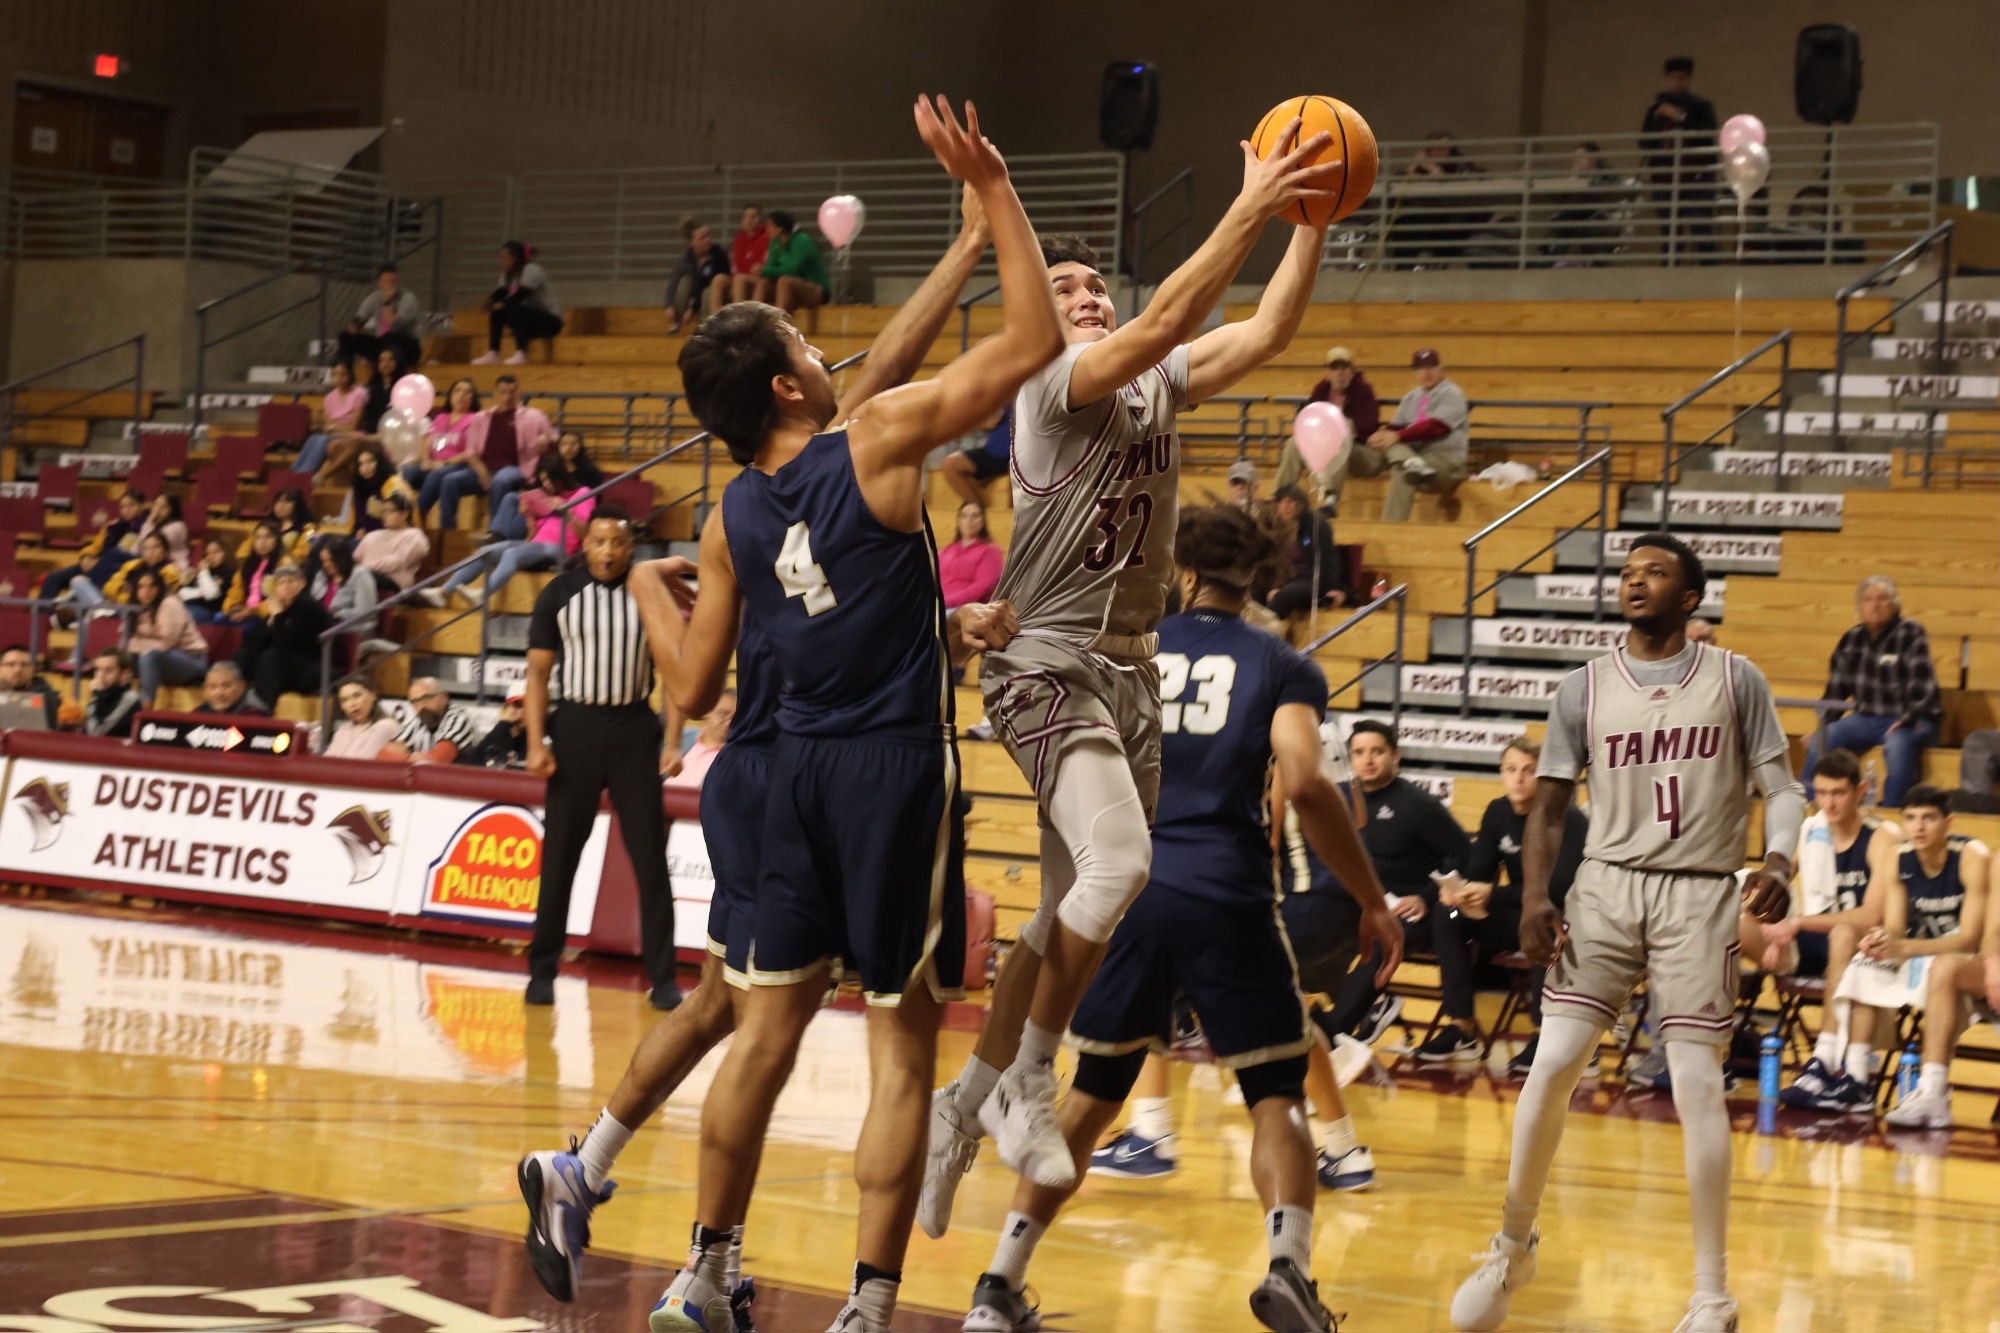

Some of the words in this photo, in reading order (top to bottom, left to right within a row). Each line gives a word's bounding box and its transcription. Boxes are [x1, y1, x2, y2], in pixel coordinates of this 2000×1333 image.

[1954, 304, 1987, 321] GO
[1886, 377, 1960, 399] TAMIU
[1725, 456, 1779, 475] FIGHT
[1760, 501, 1785, 516] OF
[1083, 491, 1154, 572] 32
[774, 520, 838, 618] 4
[1500, 626, 1526, 643] GO
[1156, 652, 1238, 736] 23
[1411, 674, 1464, 693] FIGHT
[1603, 724, 1724, 770] TAMIU
[93, 773, 318, 827] DUSTDEVILS
[1652, 773, 1682, 842] 4
[93, 832, 290, 886] ATHLETICS
[466, 832, 537, 870] TACO
